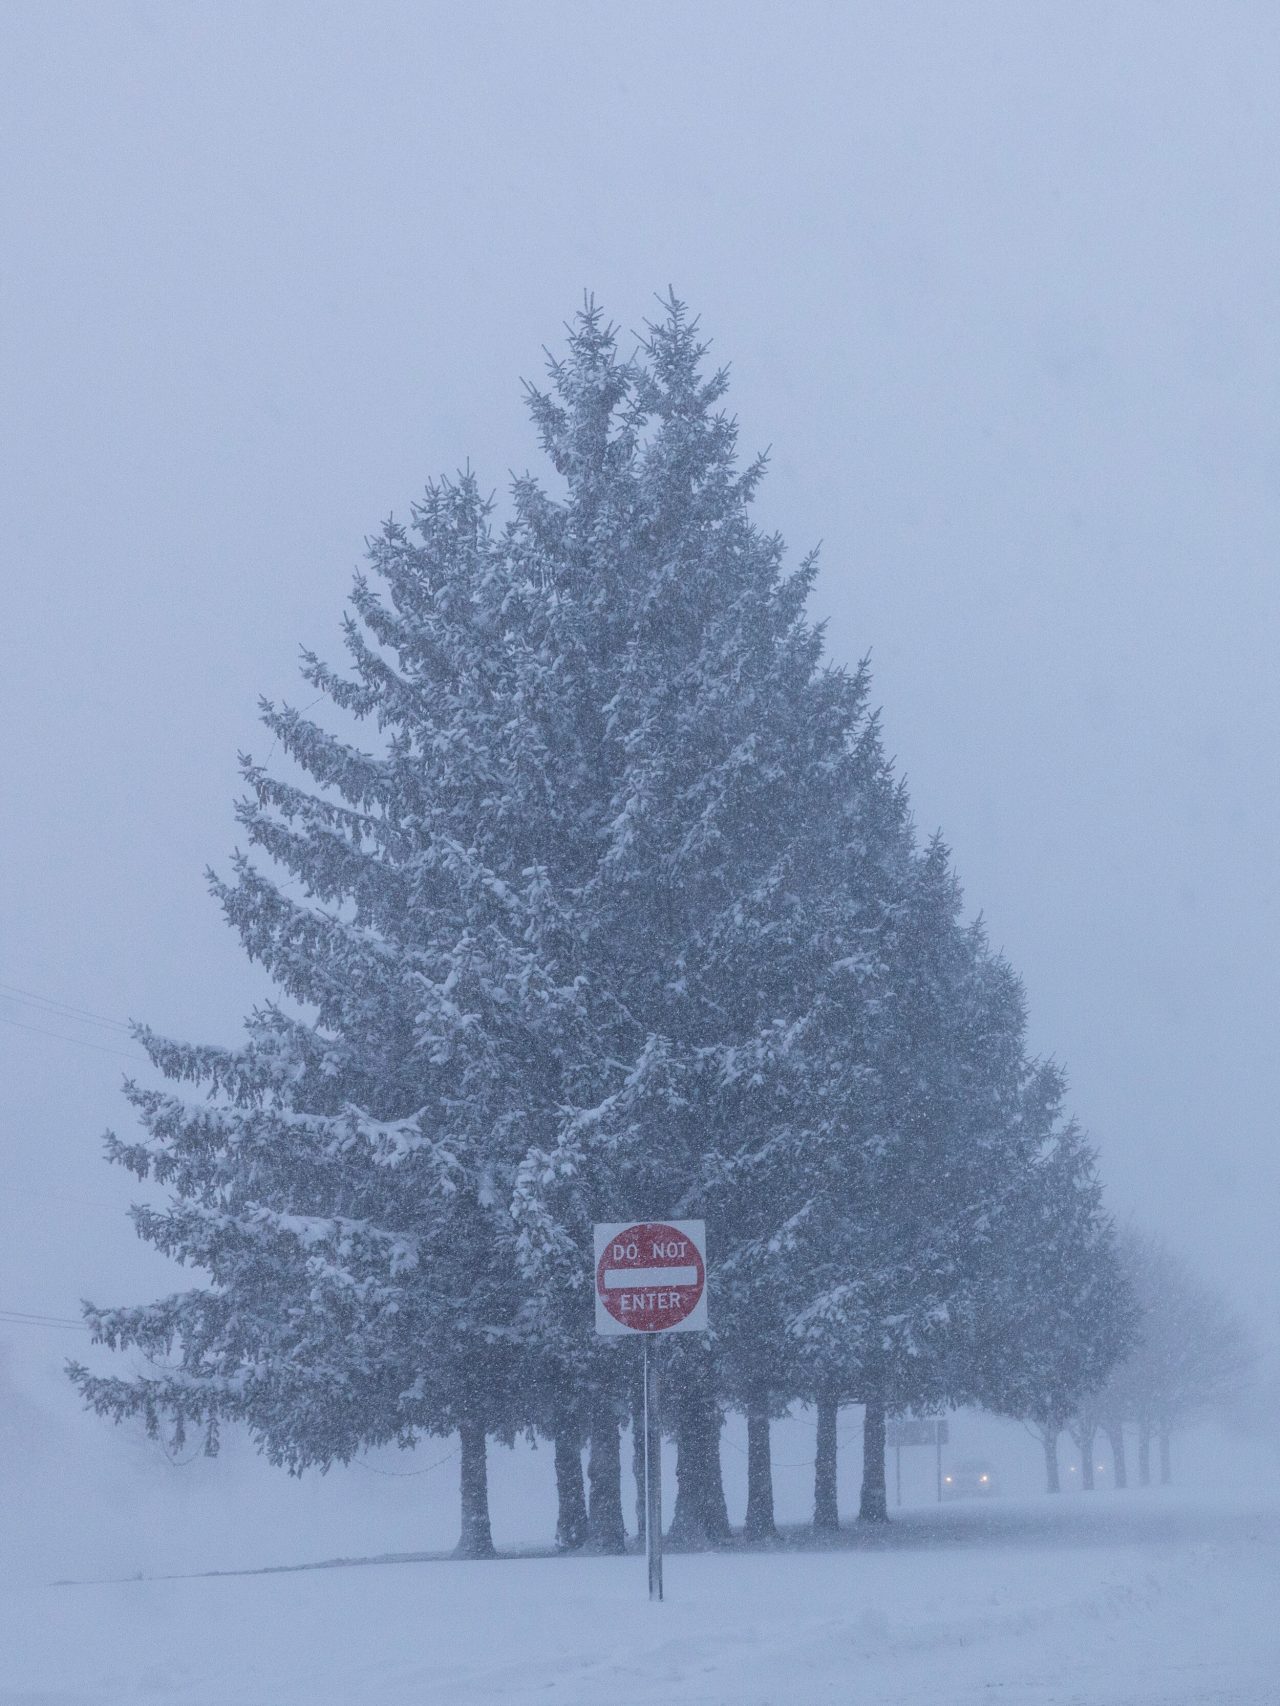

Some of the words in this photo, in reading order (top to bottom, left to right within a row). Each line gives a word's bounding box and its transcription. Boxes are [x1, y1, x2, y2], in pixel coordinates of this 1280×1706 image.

[613, 1243, 638, 1260] DO
[652, 1242, 688, 1259] NOT
[620, 1292, 681, 1311] ENTER
